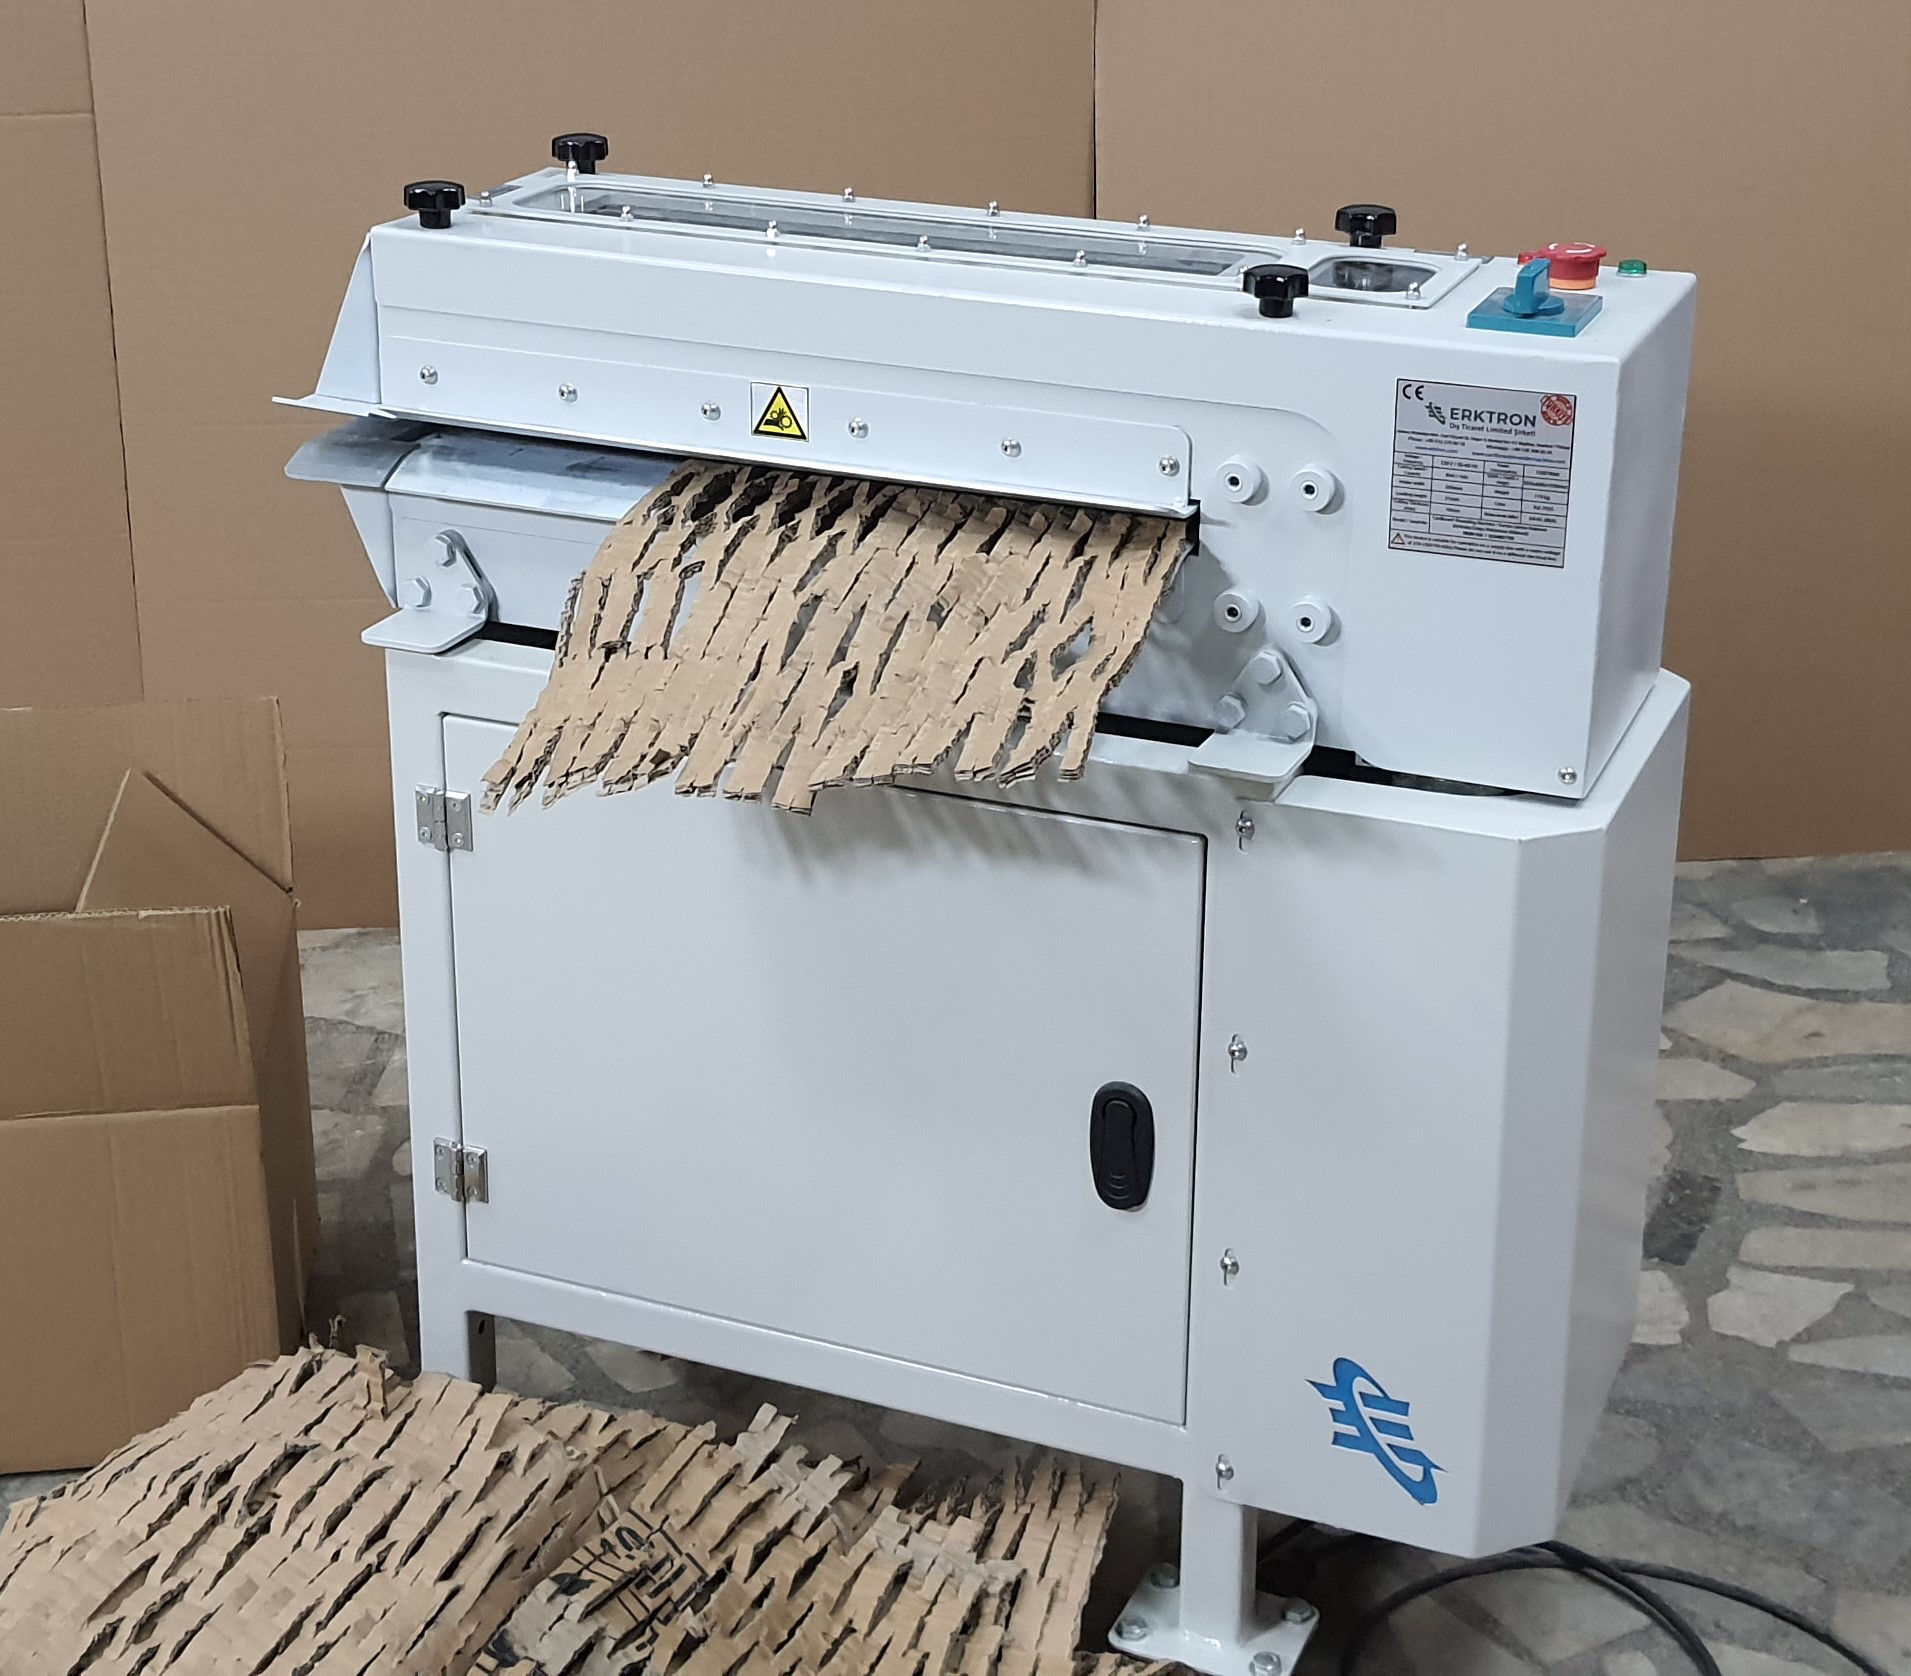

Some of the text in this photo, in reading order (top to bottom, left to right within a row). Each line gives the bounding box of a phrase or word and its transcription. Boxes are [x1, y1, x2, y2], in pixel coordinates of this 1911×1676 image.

[1450, 407, 1537, 428] ERKTRON
[1462, 423, 1485, 432] Ticaret
[1487, 426, 1513, 435] Limited
